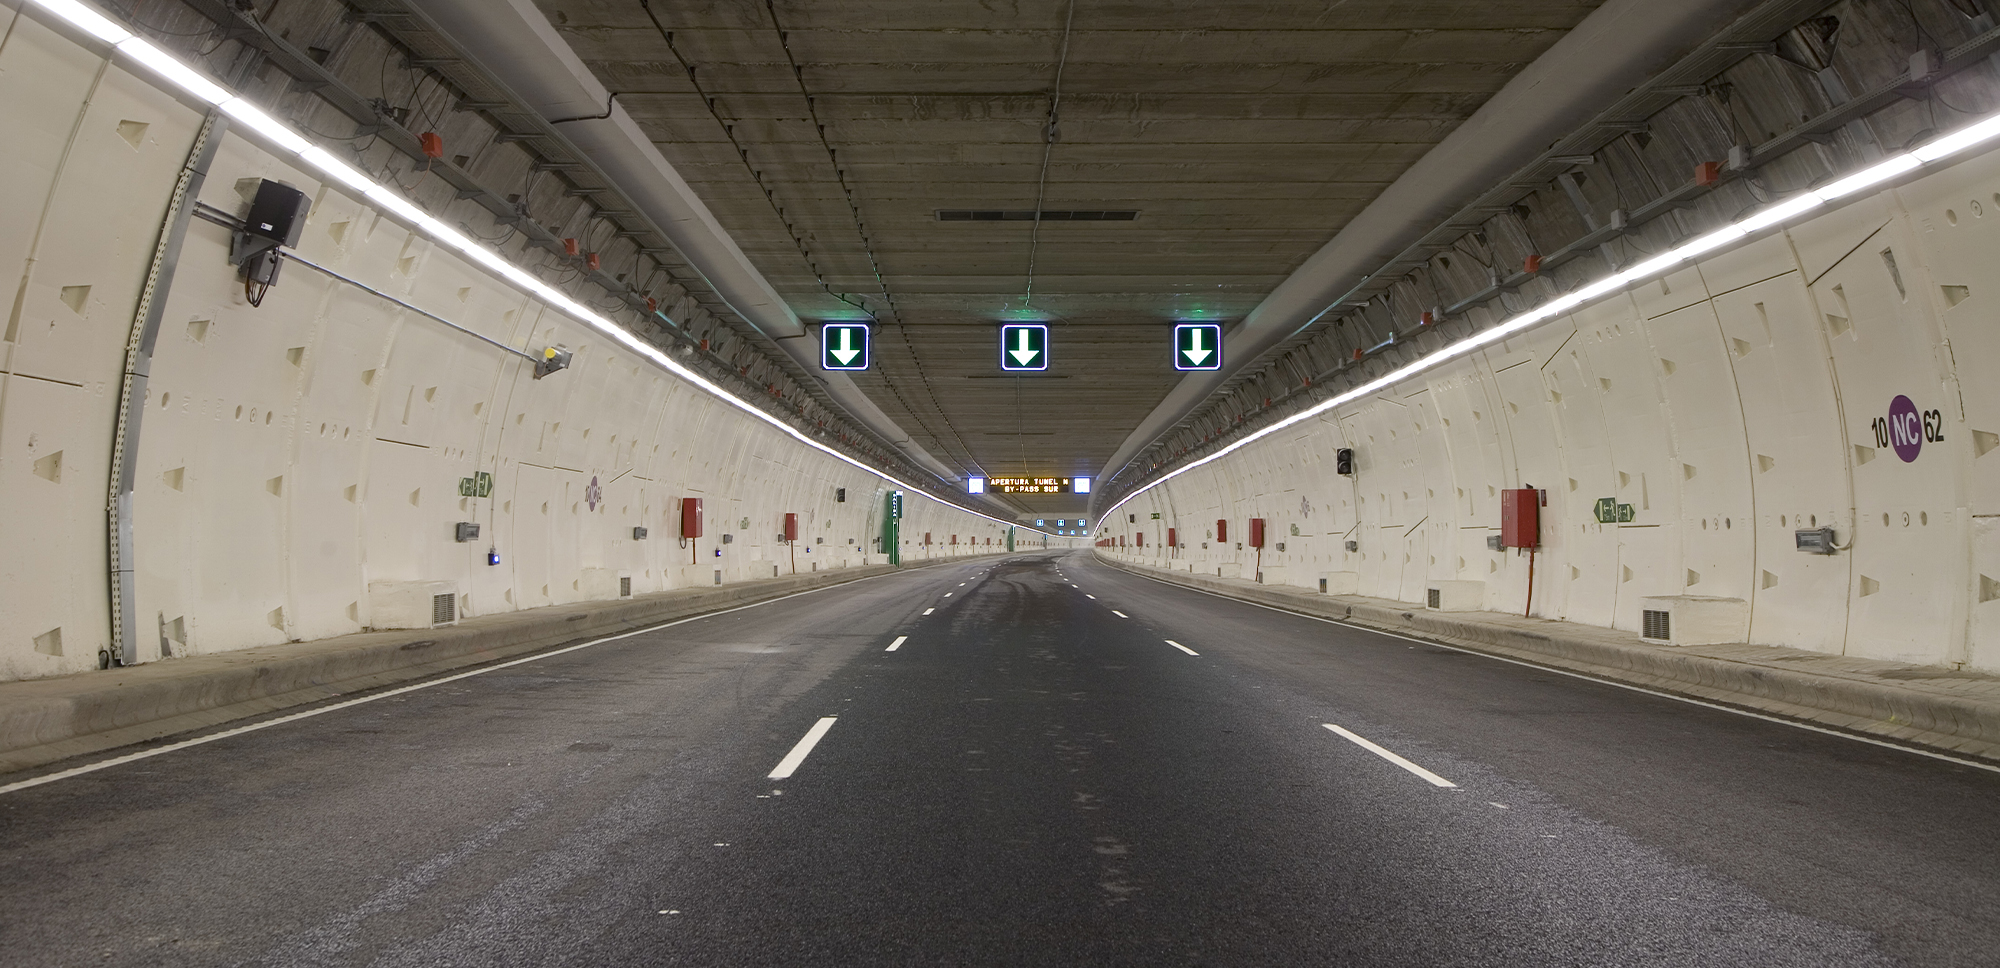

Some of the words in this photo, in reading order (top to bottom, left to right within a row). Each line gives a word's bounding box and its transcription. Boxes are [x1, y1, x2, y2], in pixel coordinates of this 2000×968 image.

[1871, 416, 1889, 449] 10
[1892, 411, 1919, 447] NC
[1923, 409, 1945, 443] 62
[990, 478, 1030, 486] APERTURA
[1004, 485, 1040, 493] BY-PASS
[1043, 485, 1059, 493] SUR
